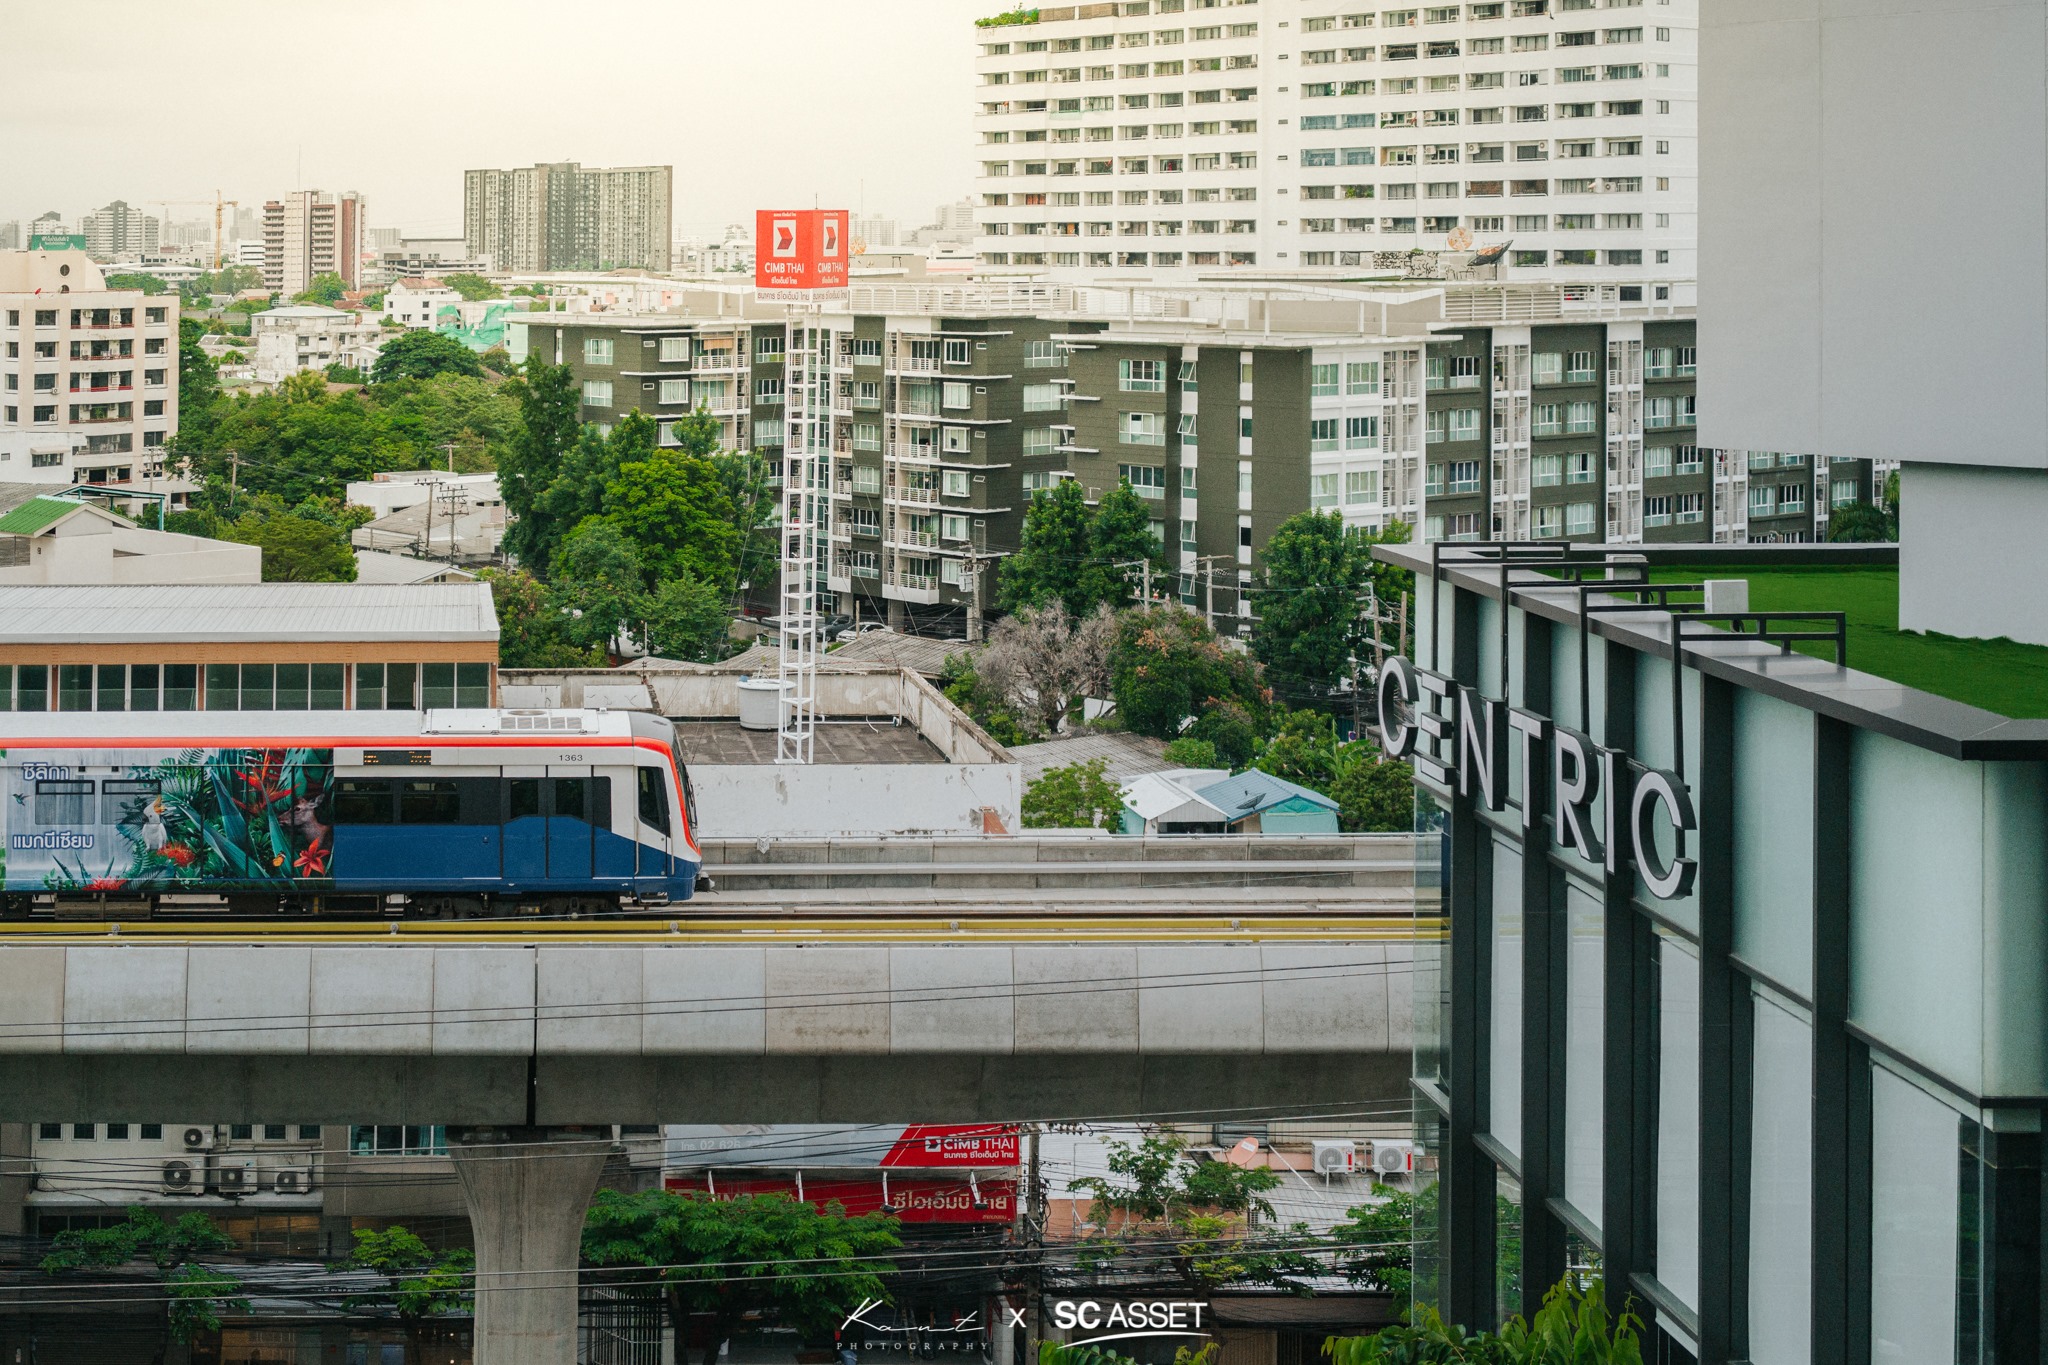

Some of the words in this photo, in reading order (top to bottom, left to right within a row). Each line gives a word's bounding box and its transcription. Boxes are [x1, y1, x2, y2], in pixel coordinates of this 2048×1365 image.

[764, 262, 786, 274] CIMB
[786, 262, 804, 274] THAI
[818, 262, 832, 273] CIMB
[832, 262, 844, 272] THAI
[559, 754, 583, 762] 1363
[23, 762, 70, 780] ซิลิกา
[1378, 655, 1698, 900] CENTRIC
[13, 831, 94, 849] แมกนีเซียม
[700, 1140, 715, 1150] 02
[943, 1138, 980, 1150] CIMB
[983, 1138, 1014, 1150] THAI
[969, 1150, 1000, 1159] ซีไอเอ็มบี
[1001, 1150, 1014, 1158] ไทย
[893, 1191, 970, 1210] ซีไอเอ็มบี
